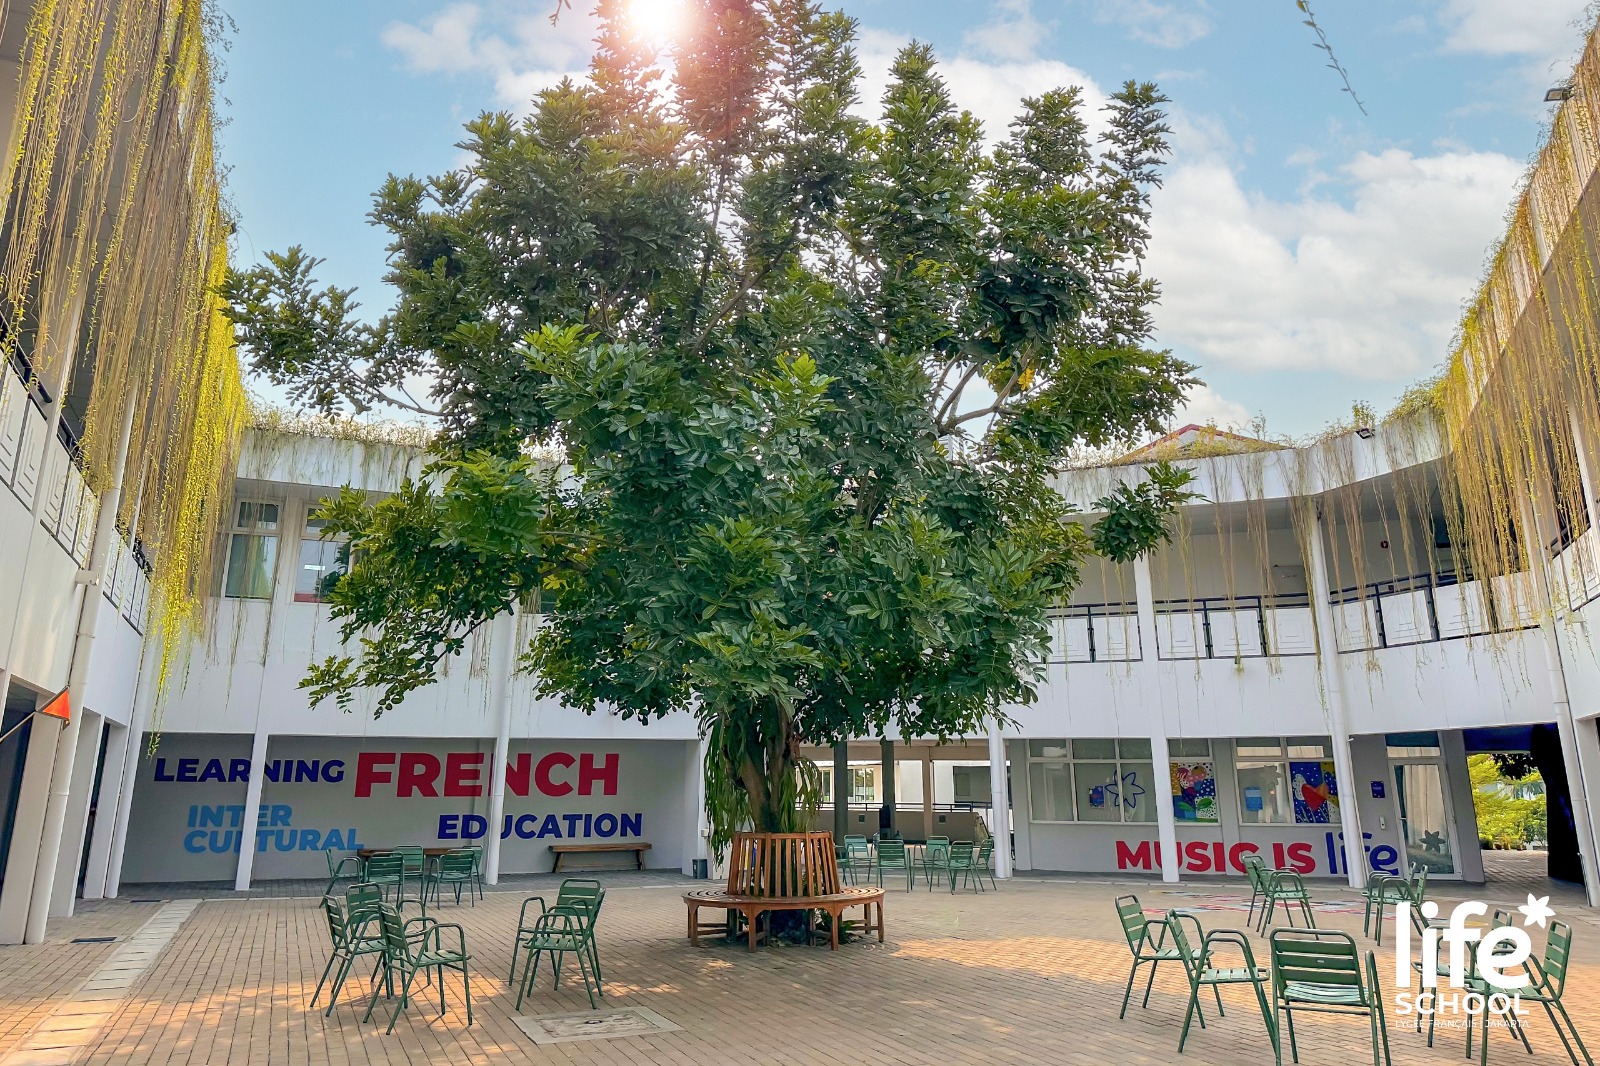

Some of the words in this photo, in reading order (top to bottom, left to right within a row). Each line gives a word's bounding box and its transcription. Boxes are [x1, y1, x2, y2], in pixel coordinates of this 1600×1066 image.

[154, 757, 345, 783] LEARNING
[354, 752, 620, 798] FRENCH
[1272, 842, 1316, 875] IS
[1325, 831, 1400, 876] lie
